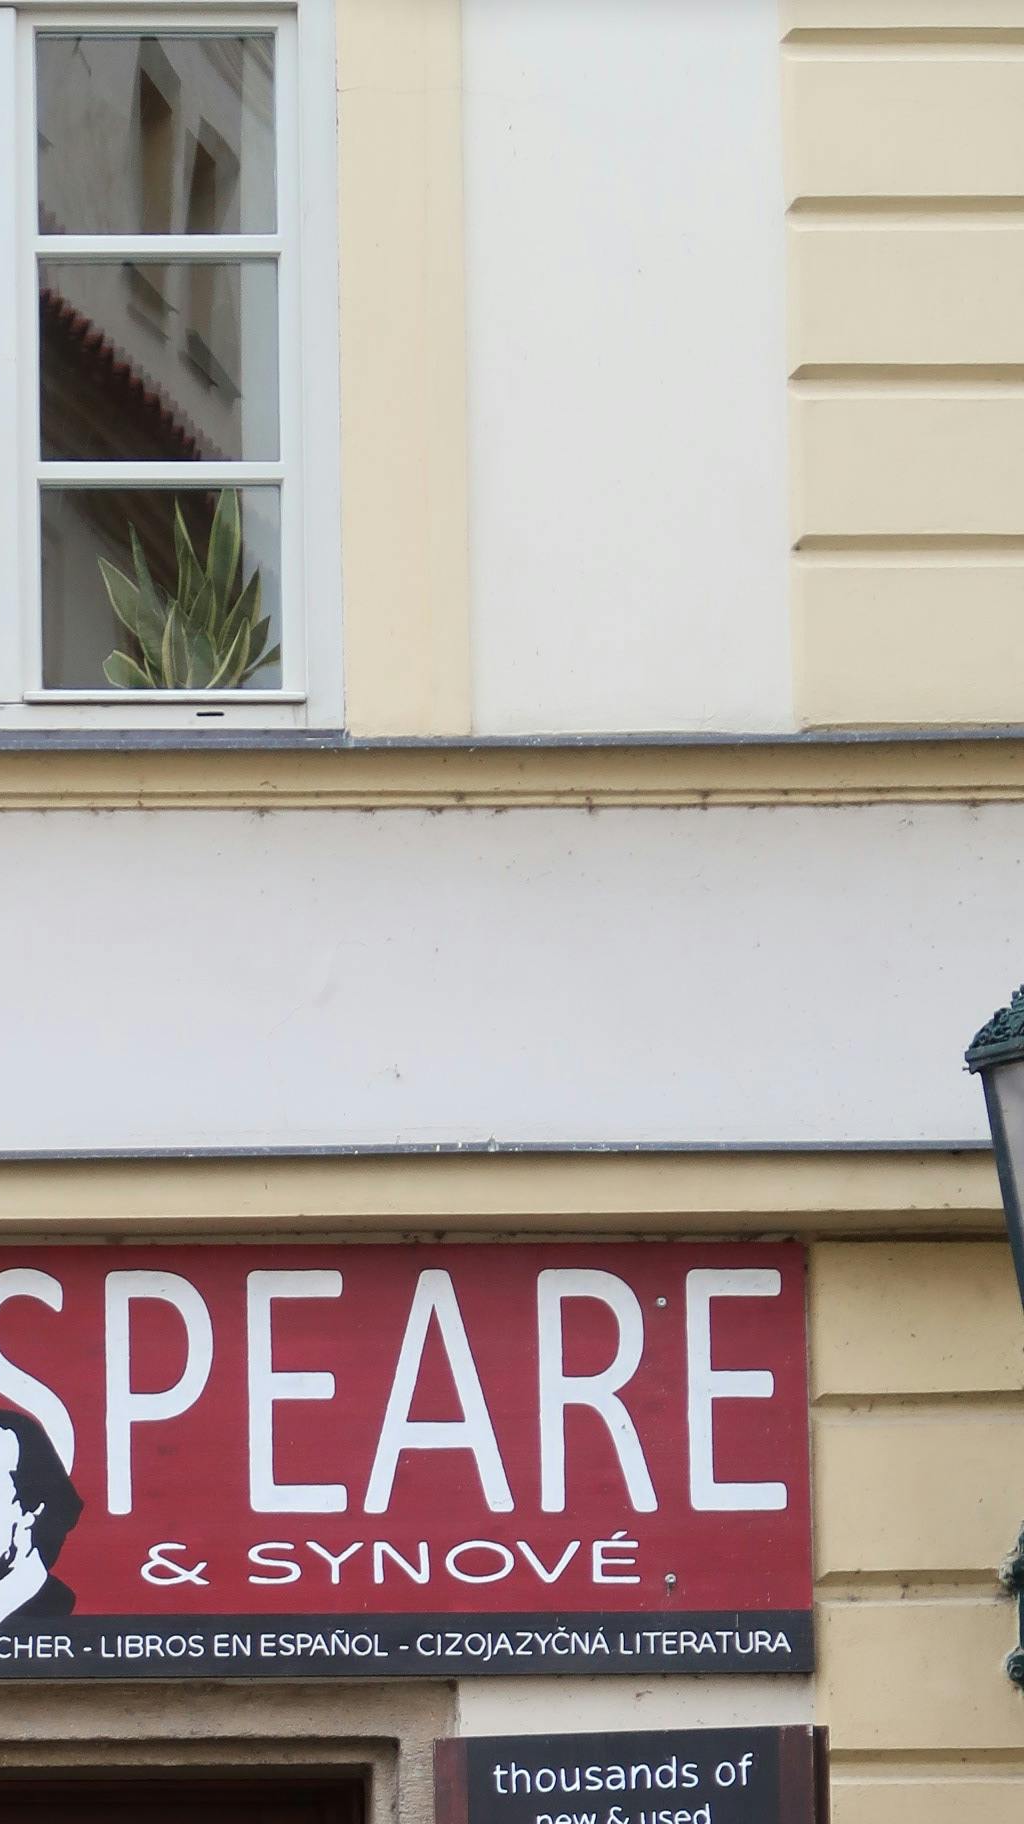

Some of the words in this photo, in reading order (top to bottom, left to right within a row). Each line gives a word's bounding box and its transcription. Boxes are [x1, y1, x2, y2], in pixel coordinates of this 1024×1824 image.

[140, 1542, 210, 1586] &
[247, 1530, 642, 1585] SYNOVÉ
[101, 1634, 205, 1659] LIBROS
[213, 1633, 251, 1657] EN
[260, 1629, 389, 1657] ESPAÑOL
[416, 1626, 610, 1662] CIZOJAZYČNÁ
[619, 1630, 792, 1655] LITERATURA
[492, 1755, 699, 1794] thousands
[715, 1752, 754, 1787] of
